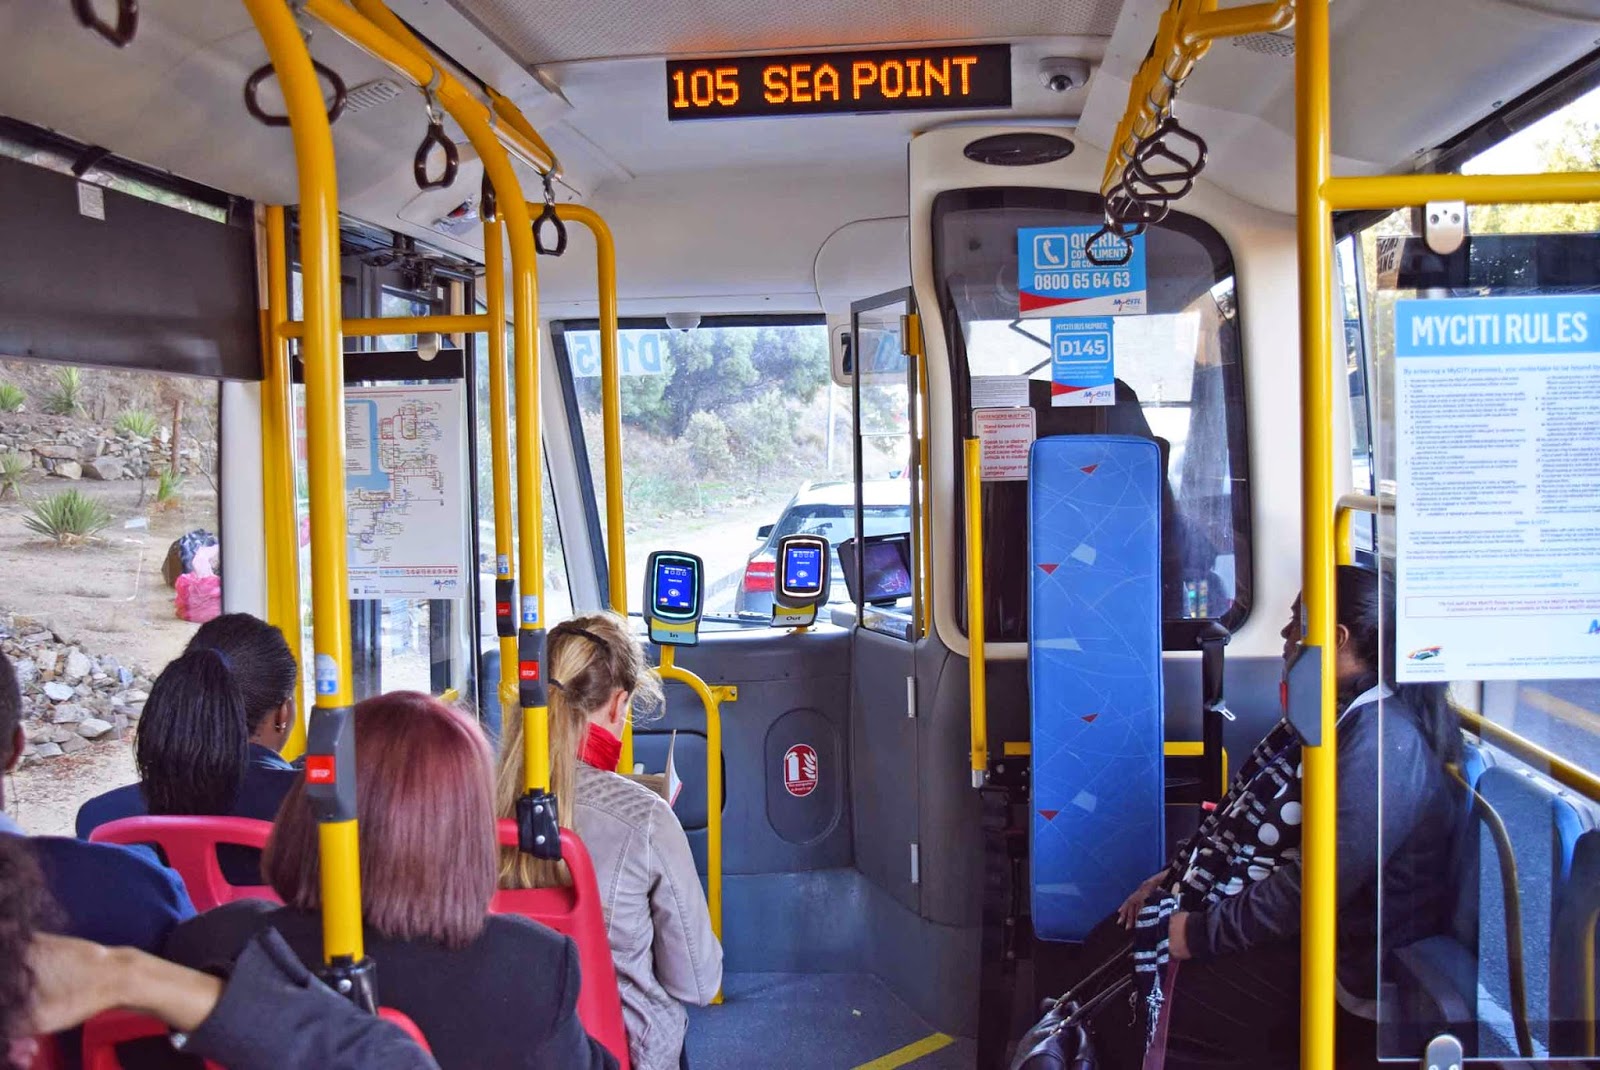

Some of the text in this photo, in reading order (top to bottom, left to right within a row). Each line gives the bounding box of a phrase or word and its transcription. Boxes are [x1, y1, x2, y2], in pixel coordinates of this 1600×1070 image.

[672, 56, 977, 108] 105 SEA POINT
[1034, 271, 1131, 290] 0800 65 64 63
[1412, 312, 1588, 347] MYCITI RULES
[1060, 339, 1106, 356] D145
[521, 669, 536, 677] STOP
[310, 769, 331, 778] STOP
